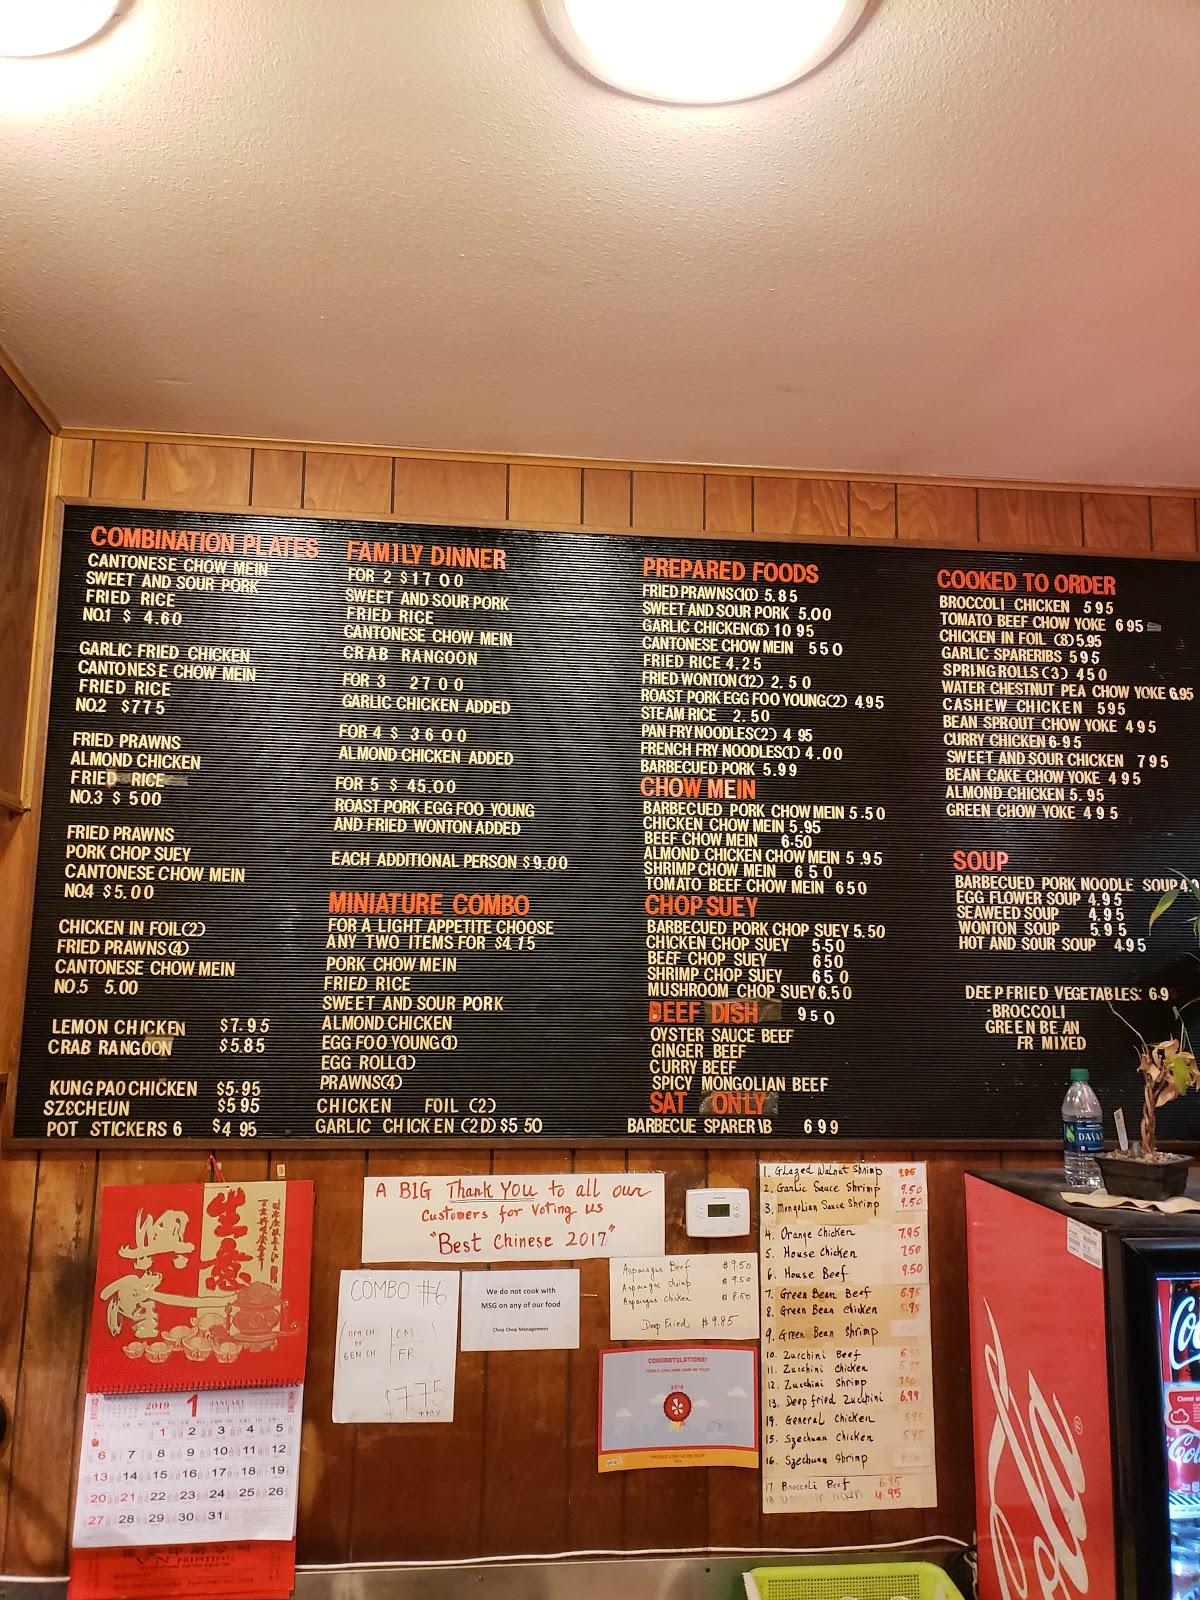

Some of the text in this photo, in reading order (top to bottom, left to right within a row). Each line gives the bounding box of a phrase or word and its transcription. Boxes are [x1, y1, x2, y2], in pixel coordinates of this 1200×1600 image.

[91, 525, 319, 559] COMBINATION PLATES
[88, 553, 268, 576] CANTONESE CHOW MEIN
[347, 540, 506, 570] FAMILY DINNER
[642, 557, 819, 584] PREPARED FOODS
[937, 569, 1116, 595] COOKED TO ORDER
[642, 602, 832, 621] SWEET AND SOUR PORK 5.00
[939, 595, 1004, 610] BROCCOLI
[1014, 598, 1070, 613] CHICKEN
[79, 641, 250, 662] GARLIC FRIED CHICKEN
[941, 646, 989, 660] GARLIC
[994, 648, 1062, 663] SPARERIBS
[643, 654, 762, 670] FRIED RICE 4.25
[942, 680, 1194, 700] WATER CHESTNUT PEA CHOW YOKE 6.95
[342, 694, 511, 714] GARLIC CHICKEN ADDED
[73, 732, 181, 750] FRIED PRAWNS
[640, 759, 798, 776] BARBECUED PORK 5.99
[640, 776, 756, 799] CHOW MEIN
[66, 845, 191, 862] PORK CHOP SUEY
[332, 851, 568, 870] EACH ADDITIONAL PERSON $9.00
[953, 851, 1008, 871] SOUP
[328, 892, 529, 915] MINIATURE COMBO
[644, 895, 758, 917] CHOP SUEY
[328, 918, 554, 935] FOR A LIGHT APPETITE CHOOSE
[959, 936, 984, 949] HOT
[989, 937, 1016, 950] AND
[1021, 938, 1055, 951] SOUR
[1062, 938, 1096, 951] SOUP
[651, 1027, 794, 1043] OYSTER SAUCE BEEF
[48, 1038, 265, 1056] CRAB RANGOON $5.85
[652, 1076, 829, 1092] SPICY MONGOLIAN BEEF
[650, 1091, 766, 1115] SAT ONLY
[375, 1182, 386, 1198] A
[399, 1182, 431, 1199] BIG
[447, 1180, 494, 1199] Thank
[548, 1181, 565, 1198] to
[576, 1179, 600, 1198] all
[612, 1185, 651, 1198] our
[777, 1180, 807, 1193] Garlic
[814, 1181, 840, 1193] Sauce
[846, 1181, 880, 1197] Shrimp
[901, 1184, 922, 1195] 9.50
[500, 1204, 523, 1223] for
[586, 1204, 603, 1214] us
[765, 1230, 774, 1241] 4.
[781, 1226, 812, 1246] Orange
[898, 1226, 920, 1238] 7.95
[670, 1259, 691, 1281] Beef
[784, 1266, 815, 1279] House
[823, 1265, 849, 1282] Beef
[902, 1263, 923, 1276] 9.50
[351, 1280, 446, 1306] COMBO #6
[813, 1326, 834, 1338] Bean
[187, 1394, 198, 1417] 1
[214, 1447, 227, 1455] 10
[243, 1446, 255, 1454] 11
[272, 1445, 286, 1453] 12
[153, 1471, 167, 1479] 15
[242, 1467, 256, 1475] 18
[271, 1466, 284, 1474] 19
